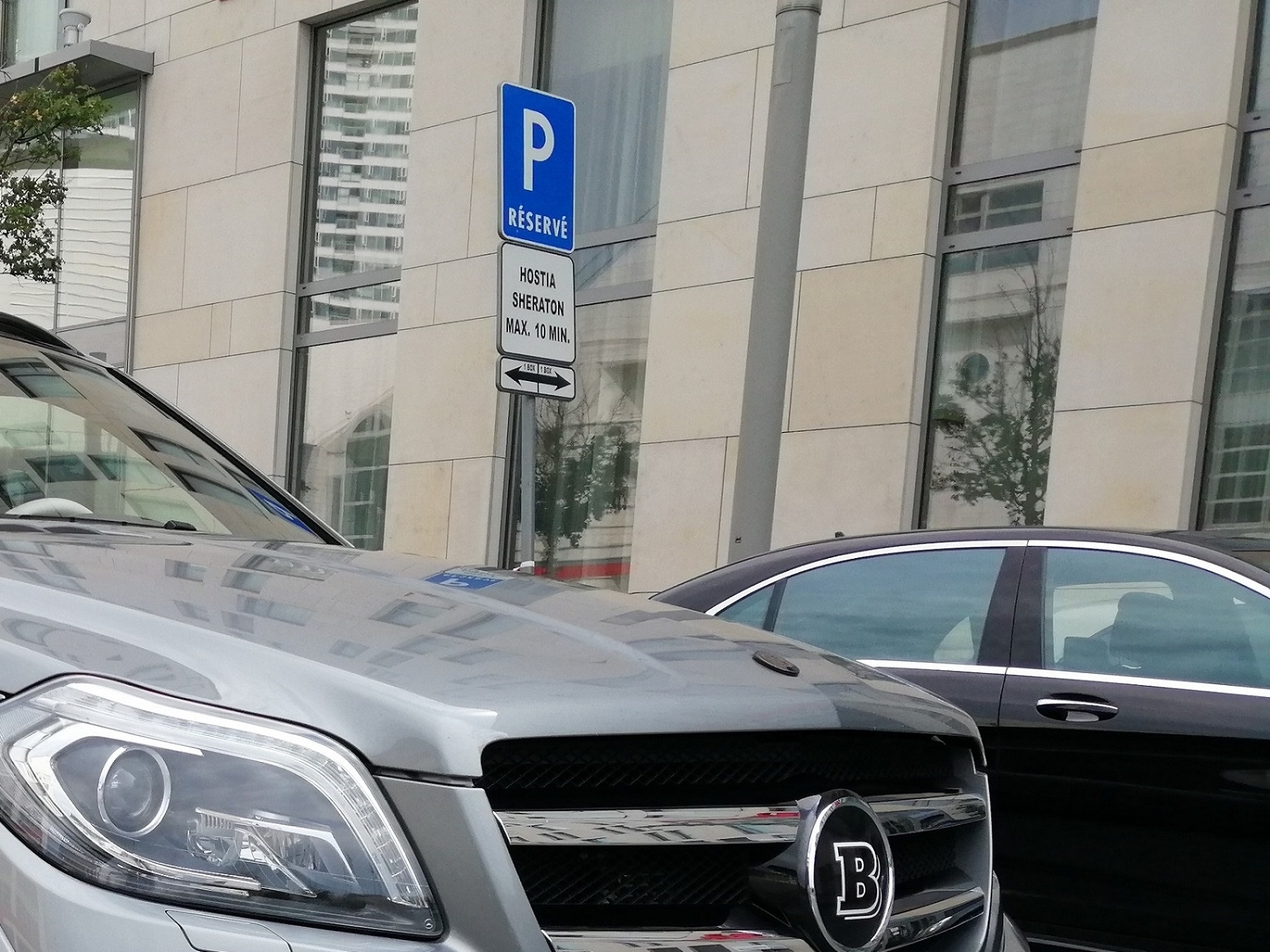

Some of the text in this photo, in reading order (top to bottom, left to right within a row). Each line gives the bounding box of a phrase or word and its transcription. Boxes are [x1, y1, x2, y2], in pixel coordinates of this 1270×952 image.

[523, 108, 555, 192] P
[508, 204, 568, 239] RÉSERVÉ
[519, 266, 556, 289] HOSTIA
[512, 291, 565, 317] SHERATON
[505, 317, 570, 344] MAX. 10 MIN.
[833, 841, 883, 920] B
